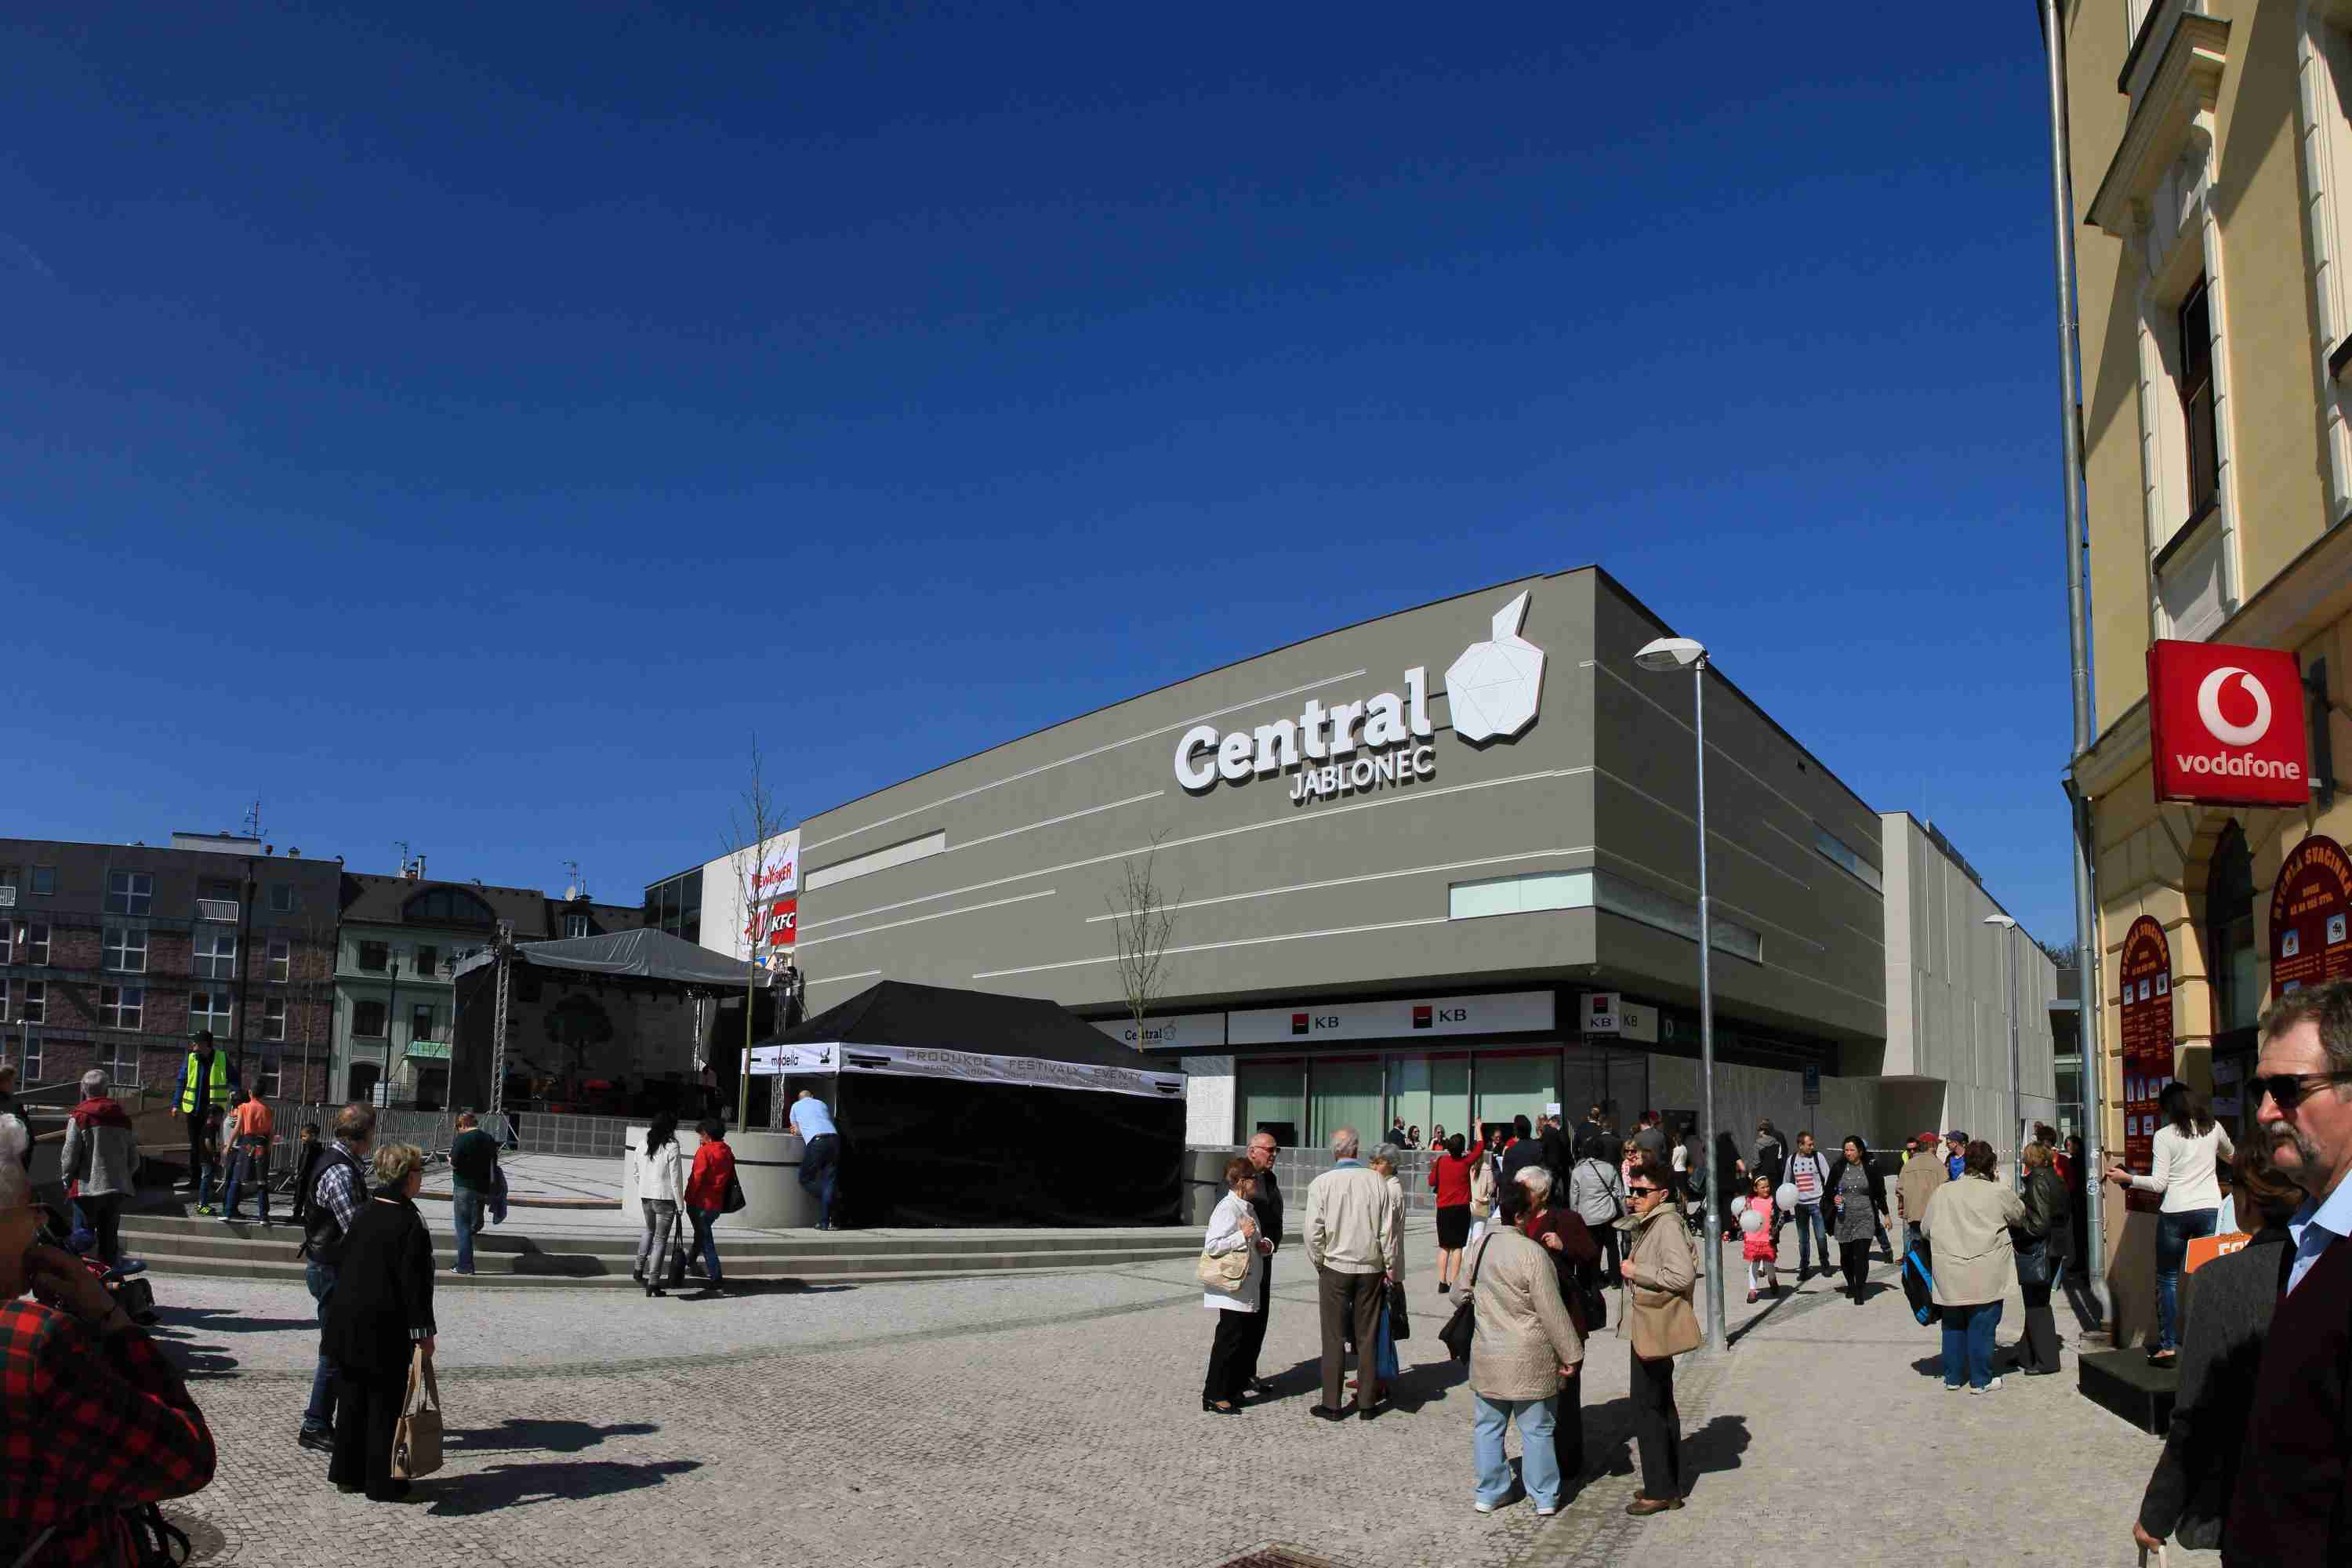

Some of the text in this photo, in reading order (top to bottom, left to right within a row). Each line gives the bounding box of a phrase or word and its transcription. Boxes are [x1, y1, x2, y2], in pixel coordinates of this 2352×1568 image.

[1174, 666, 1432, 789] Central
[1290, 745, 1436, 800] JABLONEC
[2176, 751, 2301, 779] vodafone
[771, 912, 796, 931] KFC
[1315, 1015, 1340, 1029] KB
[1439, 1008, 1467, 1023] KB
[1589, 1017, 1612, 1029] KB
[1624, 1009, 1638, 1028] KB
[1008, 1059, 1080, 1076] FESTIVALY
[1093, 1068, 1142, 1082] EVENTY
